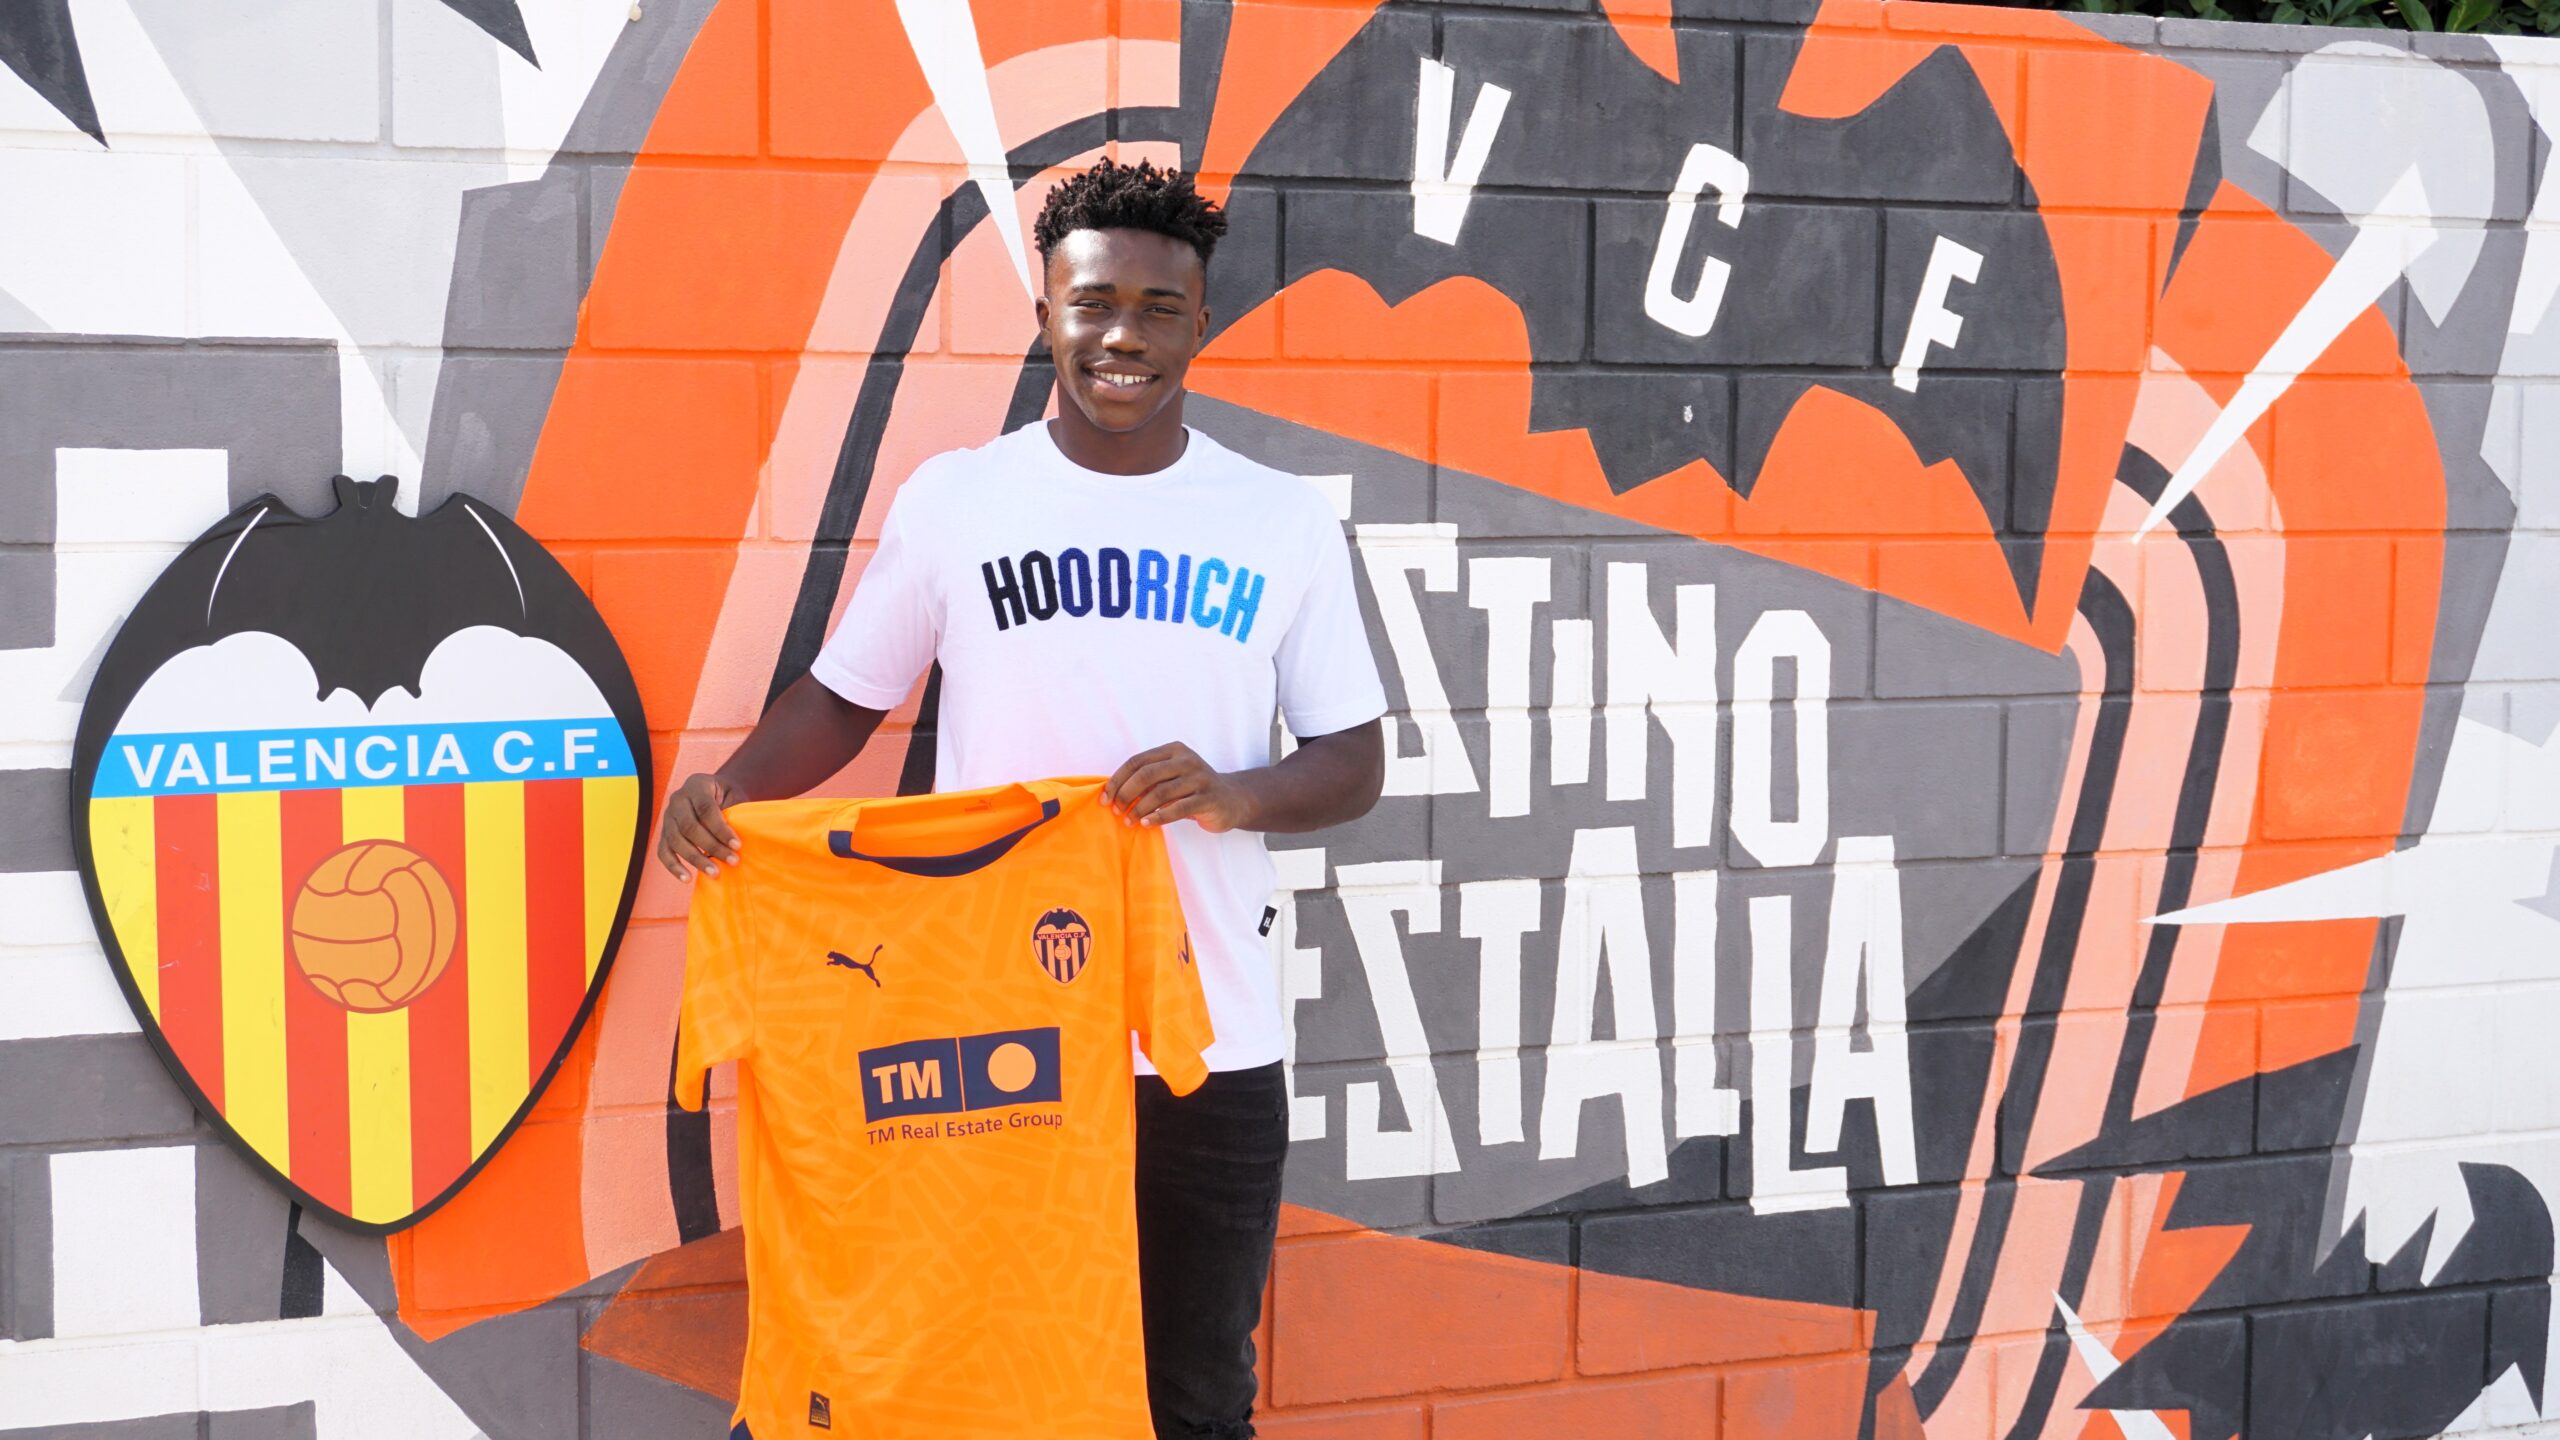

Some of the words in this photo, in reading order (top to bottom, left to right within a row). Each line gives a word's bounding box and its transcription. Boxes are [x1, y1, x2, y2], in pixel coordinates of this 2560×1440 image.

[981, 547, 1265, 643] HOODRICH
[122, 733, 471, 788] VALENCIA
[492, 728, 609, 775] C.F.
[871, 1059, 943, 1104] TM
[867, 1126, 895, 1145] TM
[902, 1121, 940, 1140] Real
[946, 1118, 1003, 1137] Estate
[1009, 1112, 1063, 1130] Group
